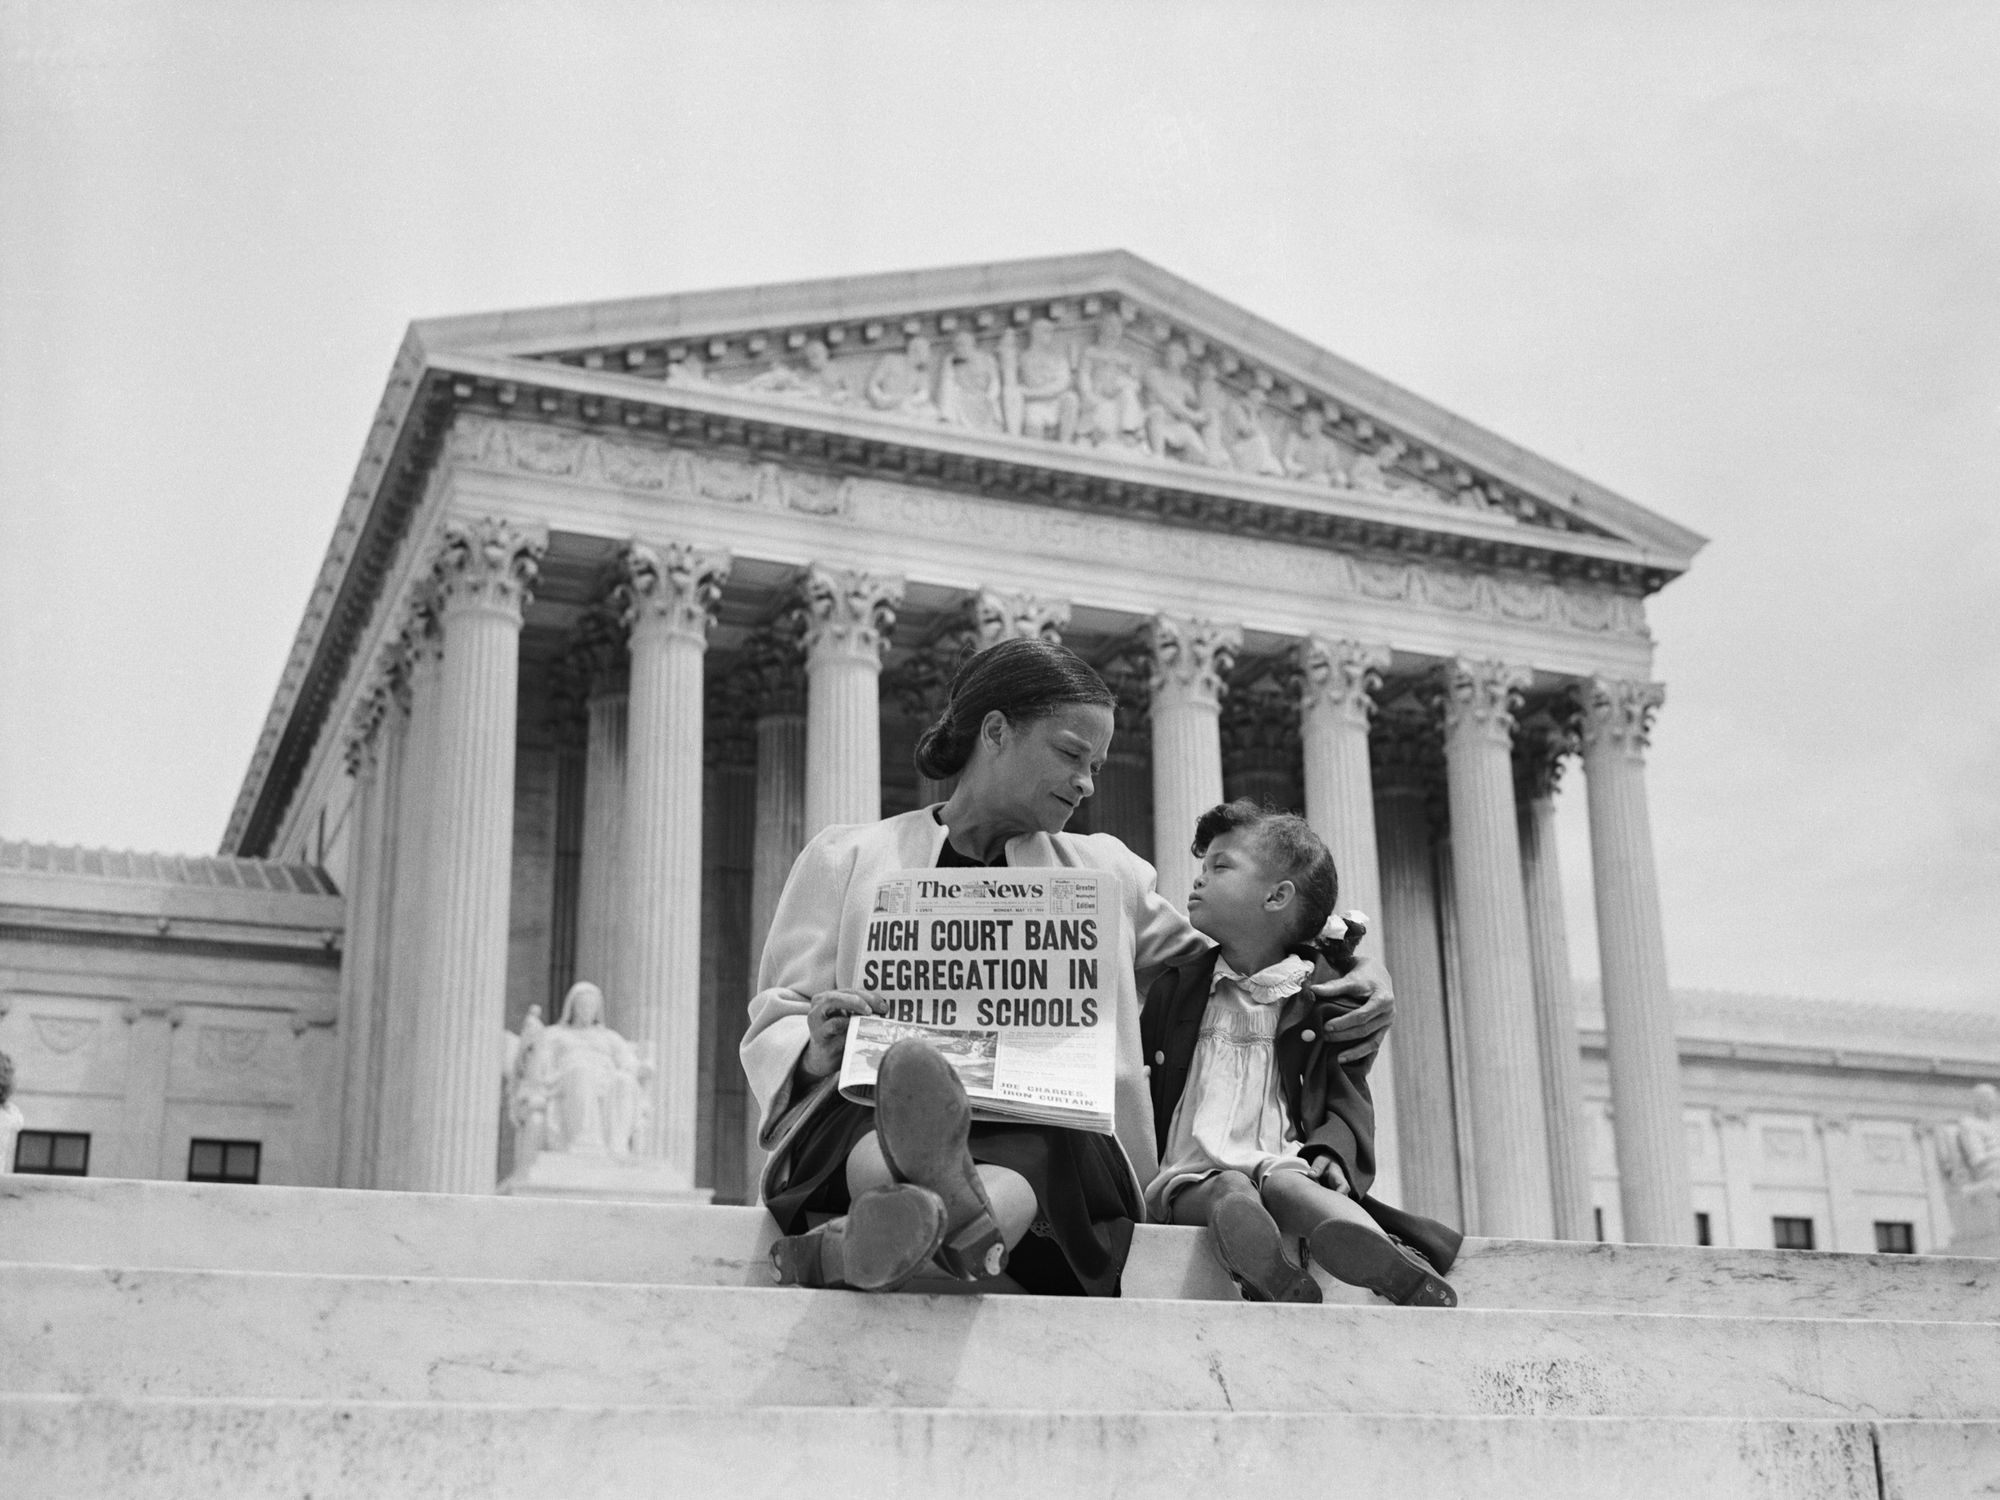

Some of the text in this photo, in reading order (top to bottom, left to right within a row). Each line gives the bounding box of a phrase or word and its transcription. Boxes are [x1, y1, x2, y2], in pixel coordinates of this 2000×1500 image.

[917, 880, 1043, 898] The News
[867, 919, 1098, 951] HIGH COURT BANS
[862, 958, 1098, 991] SEGREGATION IN
[880, 998, 1099, 1027] UBLIC SCHOOLS
